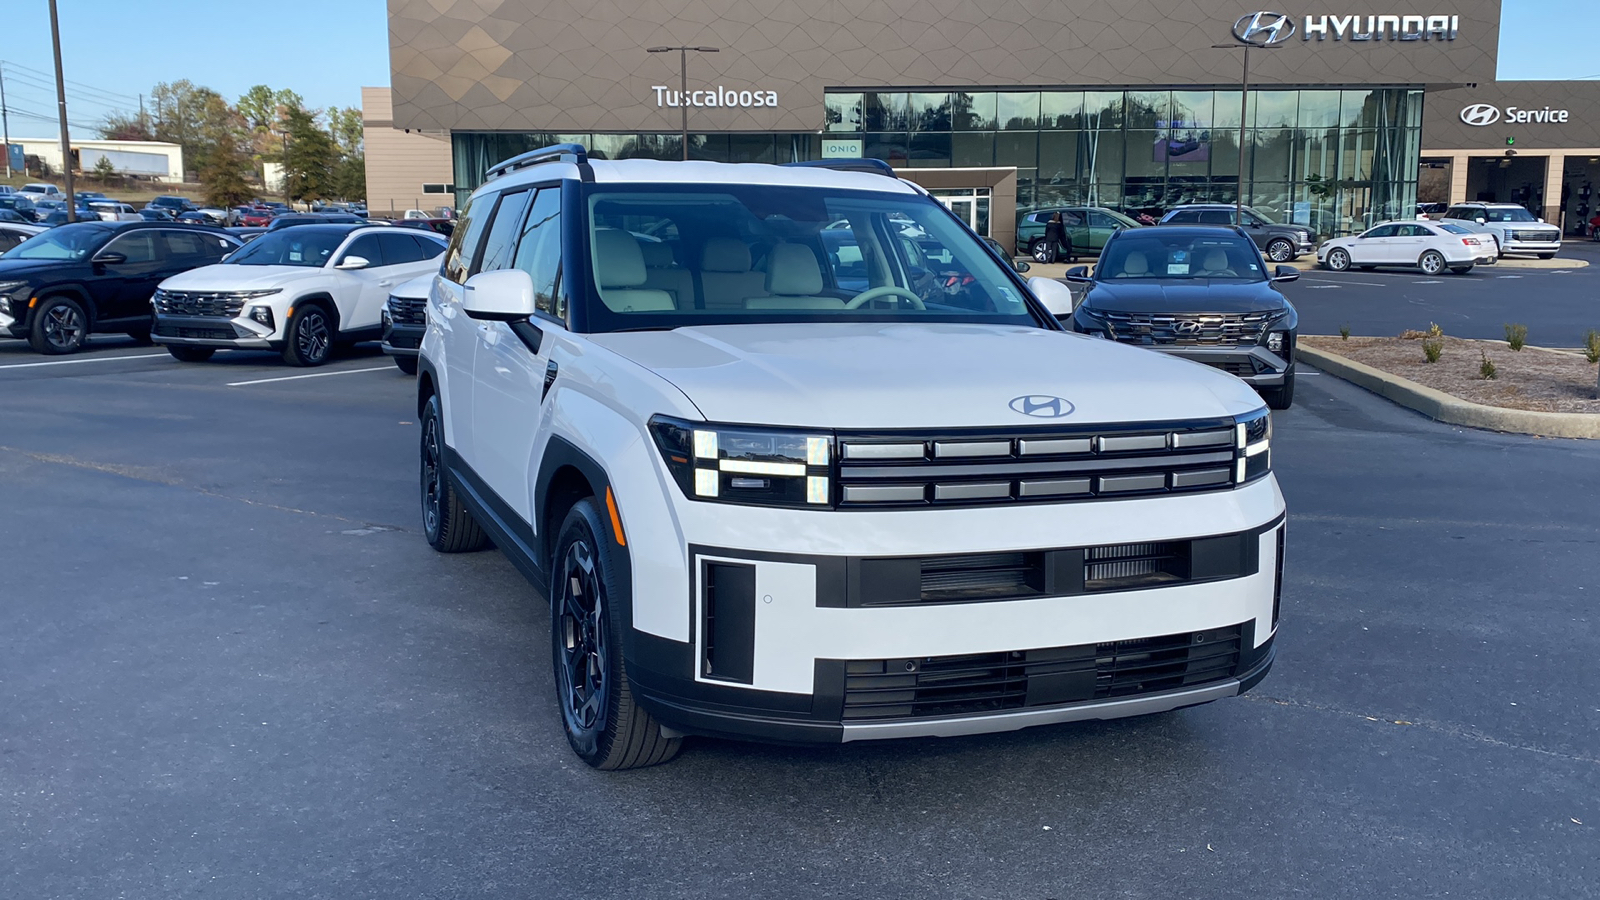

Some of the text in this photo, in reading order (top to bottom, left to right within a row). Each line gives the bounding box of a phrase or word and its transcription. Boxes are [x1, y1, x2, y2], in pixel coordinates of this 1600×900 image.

[1302, 15, 1459, 41] HYUNDAI
[651, 85, 778, 107] Tuscaloosa
[1505, 106, 1569, 123] Service
[826, 145, 857, 153] IONIQ
